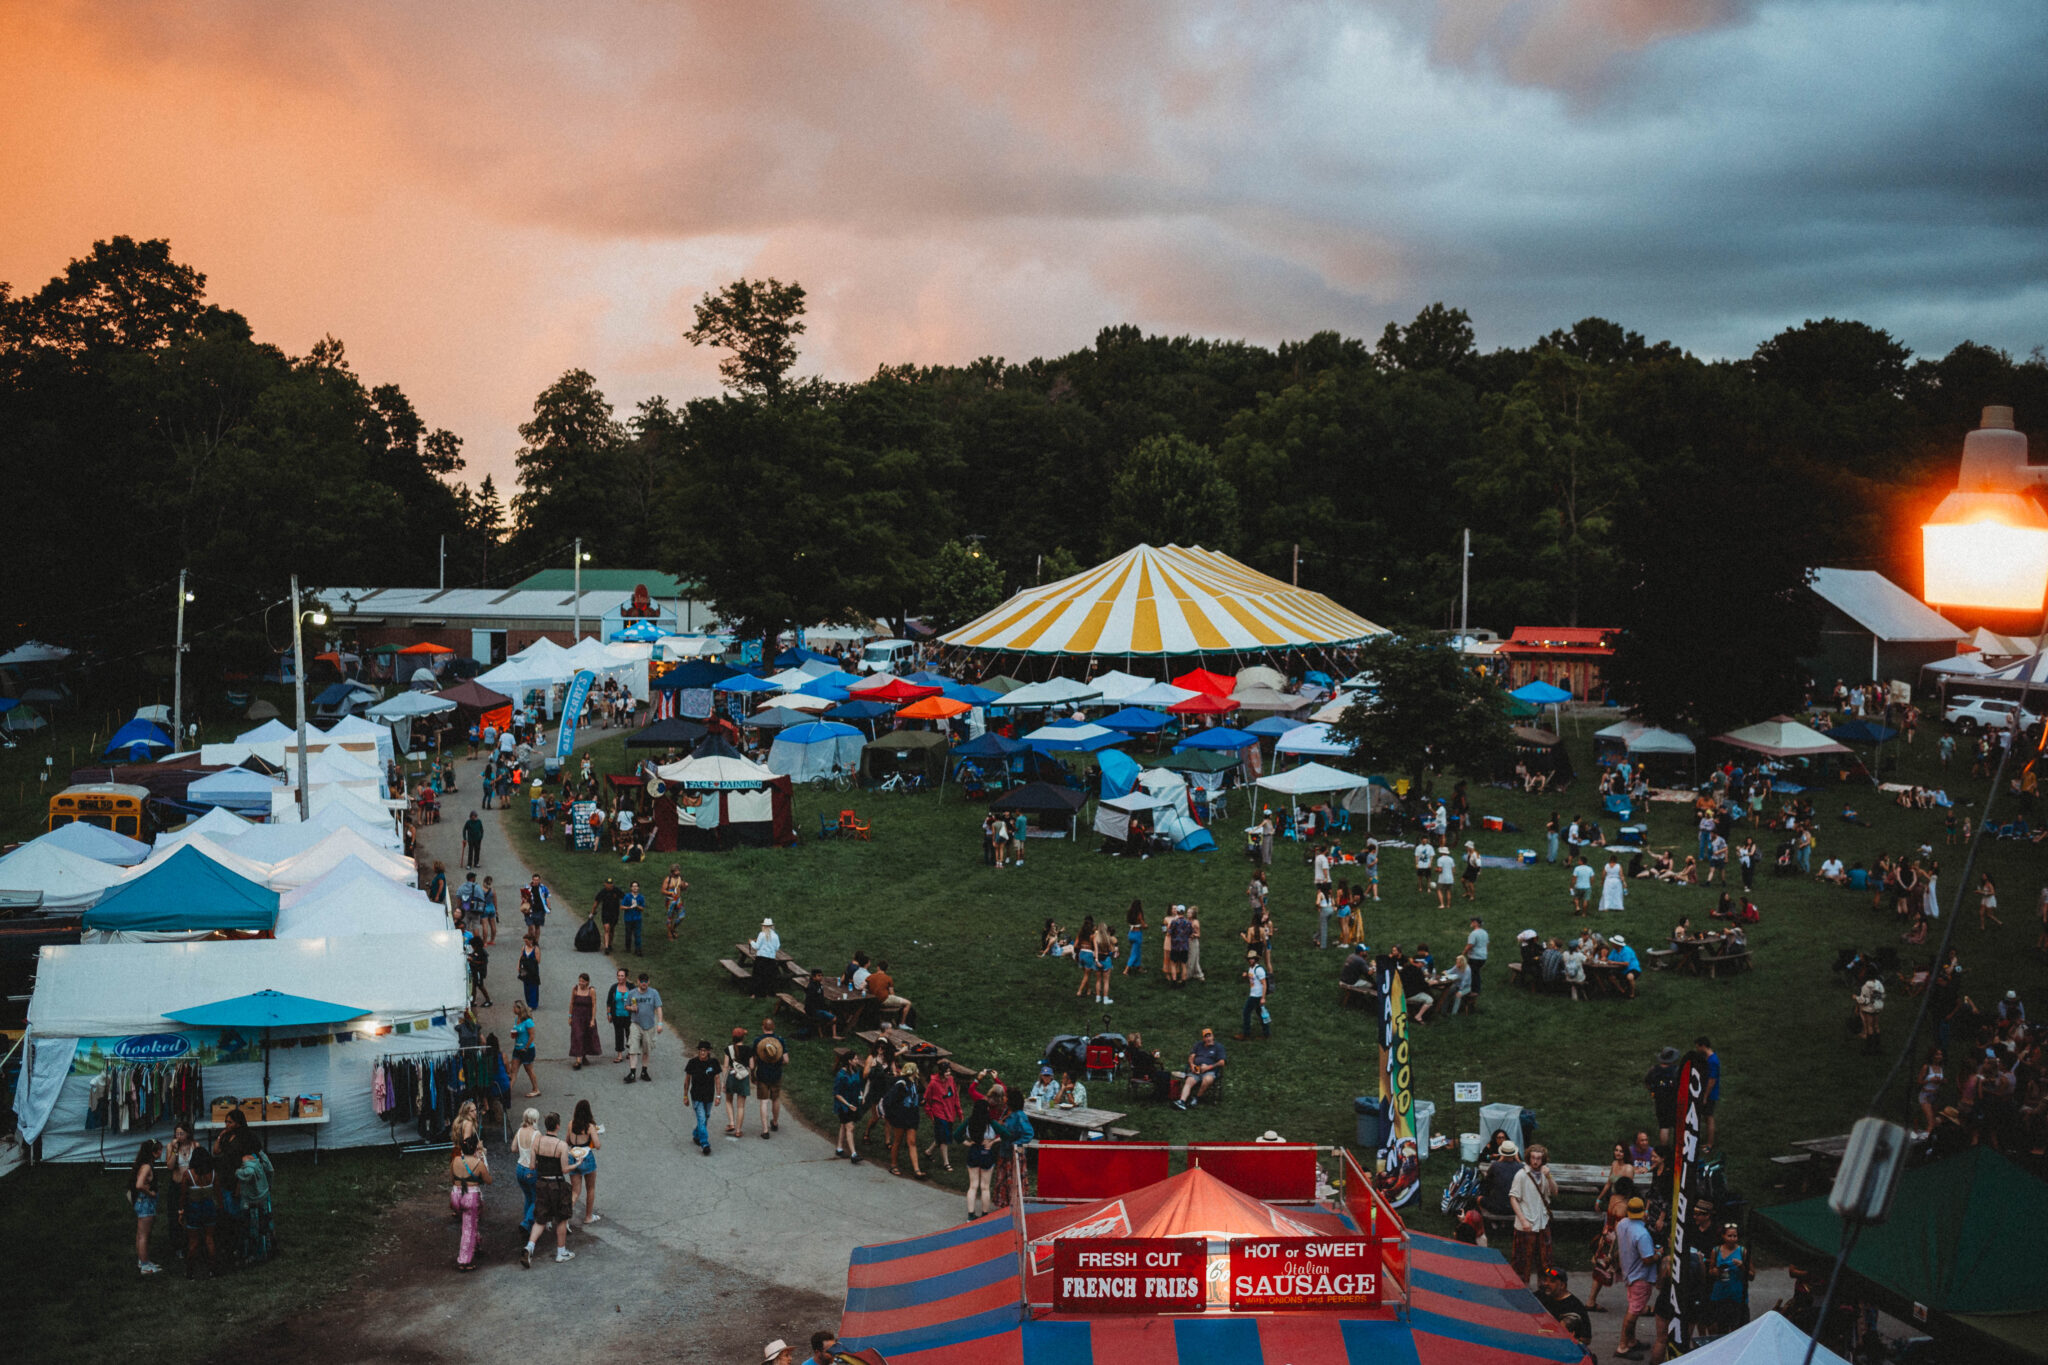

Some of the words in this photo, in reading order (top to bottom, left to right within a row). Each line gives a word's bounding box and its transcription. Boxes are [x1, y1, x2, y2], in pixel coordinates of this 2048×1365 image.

[686, 780, 715, 789] FACE
[719, 780, 762, 789] PAINTING
[120, 1039, 181, 1055] hooked
[1396, 1013, 1411, 1115] FOOD
[1244, 1243, 1281, 1259] HOT
[1285, 1248, 1300, 1258] or
[1305, 1242, 1367, 1258] SWEET
[1078, 1252, 1137, 1267] FRESH
[1145, 1252, 1182, 1267] CUT
[1282, 1261, 1330, 1278] Italian
[1062, 1277, 1137, 1298] FRENCH
[1144, 1277, 1199, 1298] FRIES
[1235, 1273, 1376, 1297] SAUSAGE
[1268, 1295, 1303, 1304] ONIONS
[1327, 1294, 1367, 1303] PEPPERS
